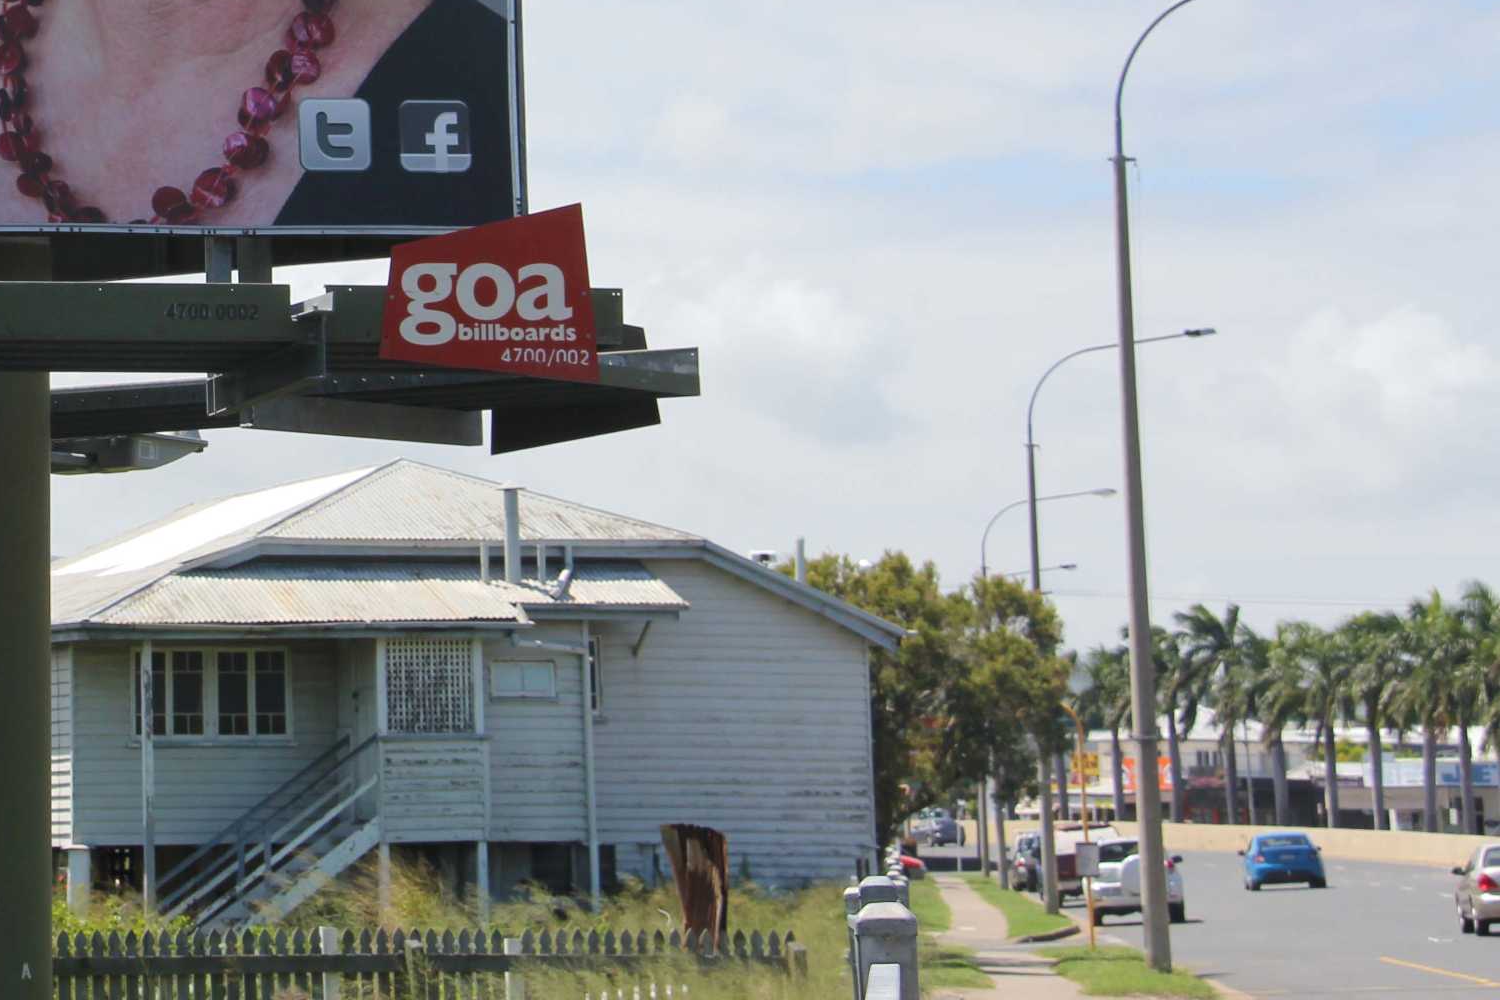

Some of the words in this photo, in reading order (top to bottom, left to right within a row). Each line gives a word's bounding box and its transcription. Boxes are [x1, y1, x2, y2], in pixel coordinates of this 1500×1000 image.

[425, 112, 458, 173] f
[164, 303, 211, 320] 4700
[399, 262, 573, 346] goa
[457, 323, 577, 342] billboards
[500, 347, 589, 367] 4700/002
